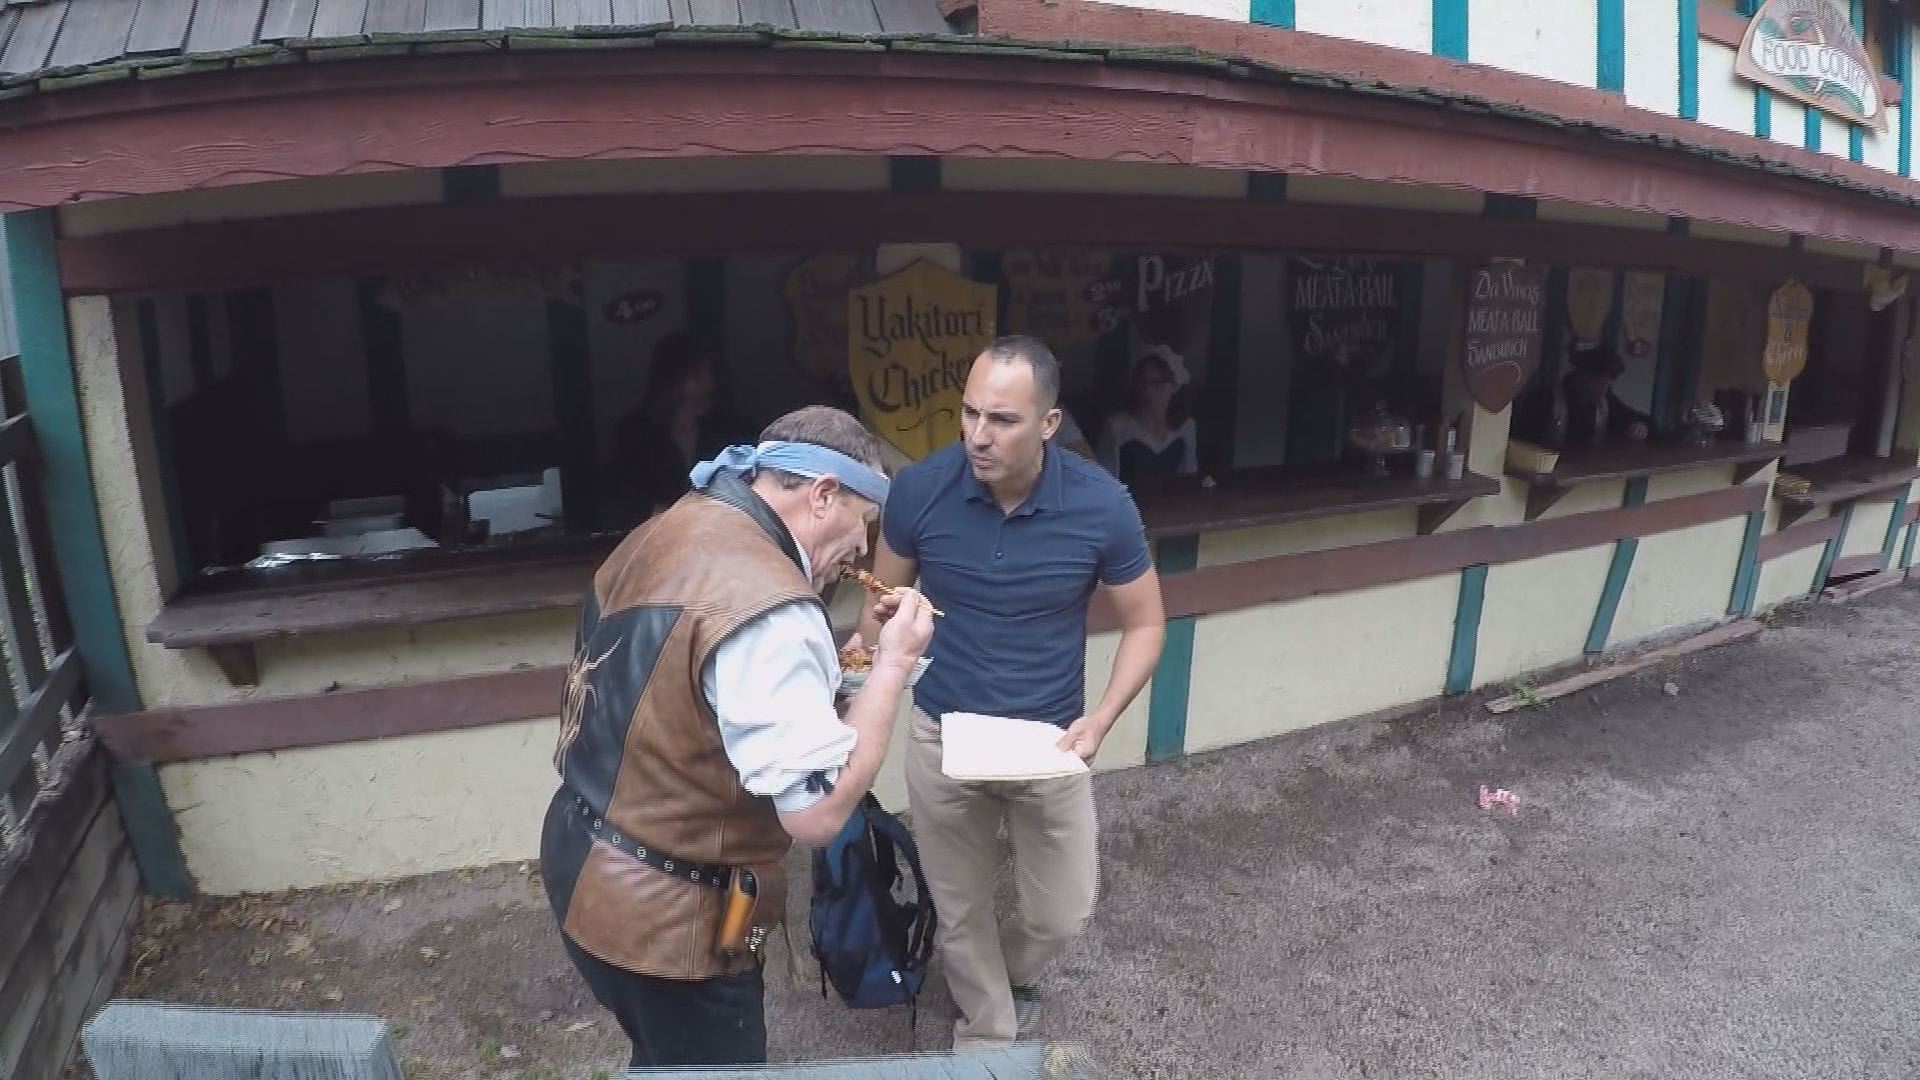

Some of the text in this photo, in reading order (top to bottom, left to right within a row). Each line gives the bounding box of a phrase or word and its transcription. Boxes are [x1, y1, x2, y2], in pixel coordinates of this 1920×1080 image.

[1762, 39, 1871, 97] FOOD COURT
[857, 293, 986, 358] Yakitori
[868, 350, 972, 412] Chicke
